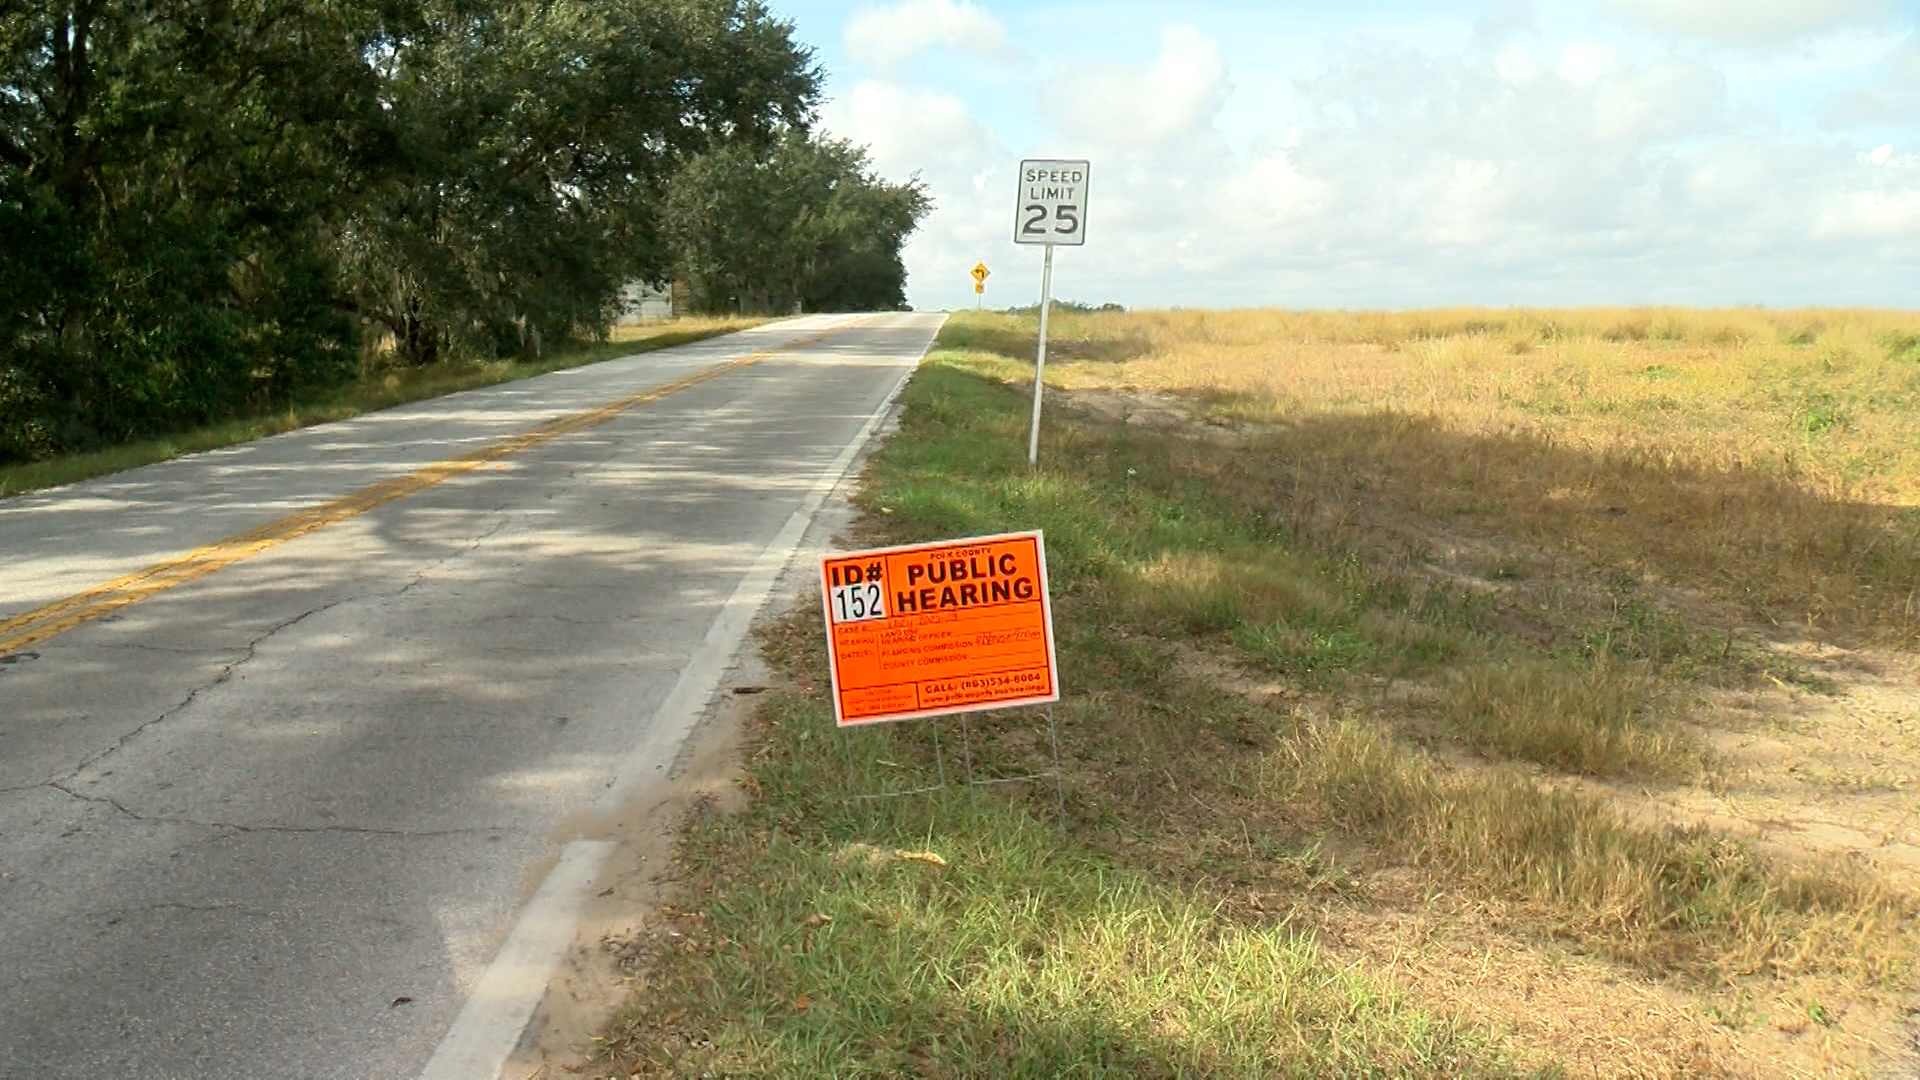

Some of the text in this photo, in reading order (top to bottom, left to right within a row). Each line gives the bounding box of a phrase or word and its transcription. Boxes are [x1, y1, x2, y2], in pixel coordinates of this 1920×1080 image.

[1026, 168, 1082, 182] SPEED
[1030, 187, 1075, 200] LIMIT
[1022, 204, 1078, 234] 25
[955, 548, 991, 558] COUNTY
[832, 562, 883, 587] ID#
[907, 553, 1017, 586] PUBLIC
[837, 583, 882, 619] 152
[897, 577, 1033, 612] HEARING
[883, 653, 967, 670] COUNTY COMMISSION
